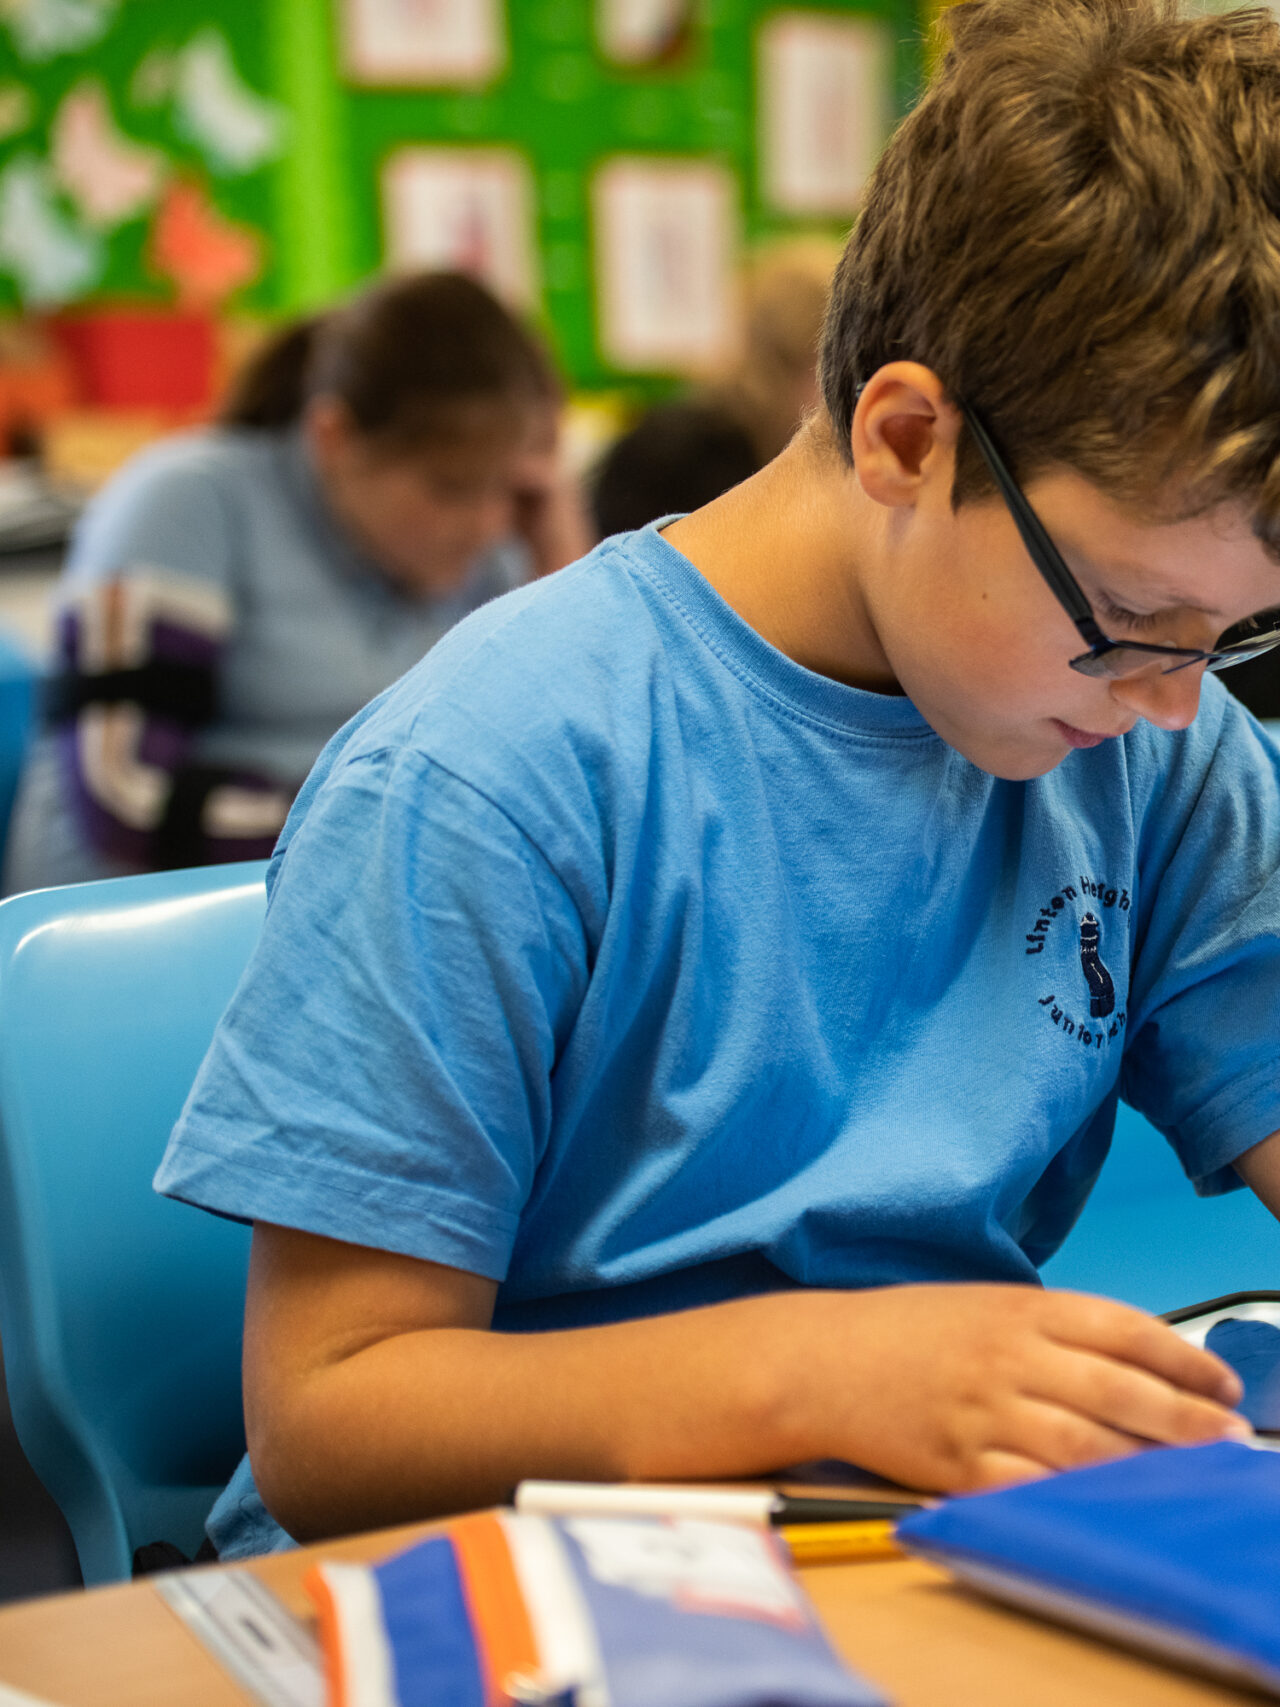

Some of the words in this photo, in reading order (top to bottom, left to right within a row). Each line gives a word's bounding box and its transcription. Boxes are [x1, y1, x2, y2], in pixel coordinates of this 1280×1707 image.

[1025, 885, 1077, 954] Linton
[1079, 875, 1131, 912] Heigh
[1038, 994, 1104, 1049] Junior
